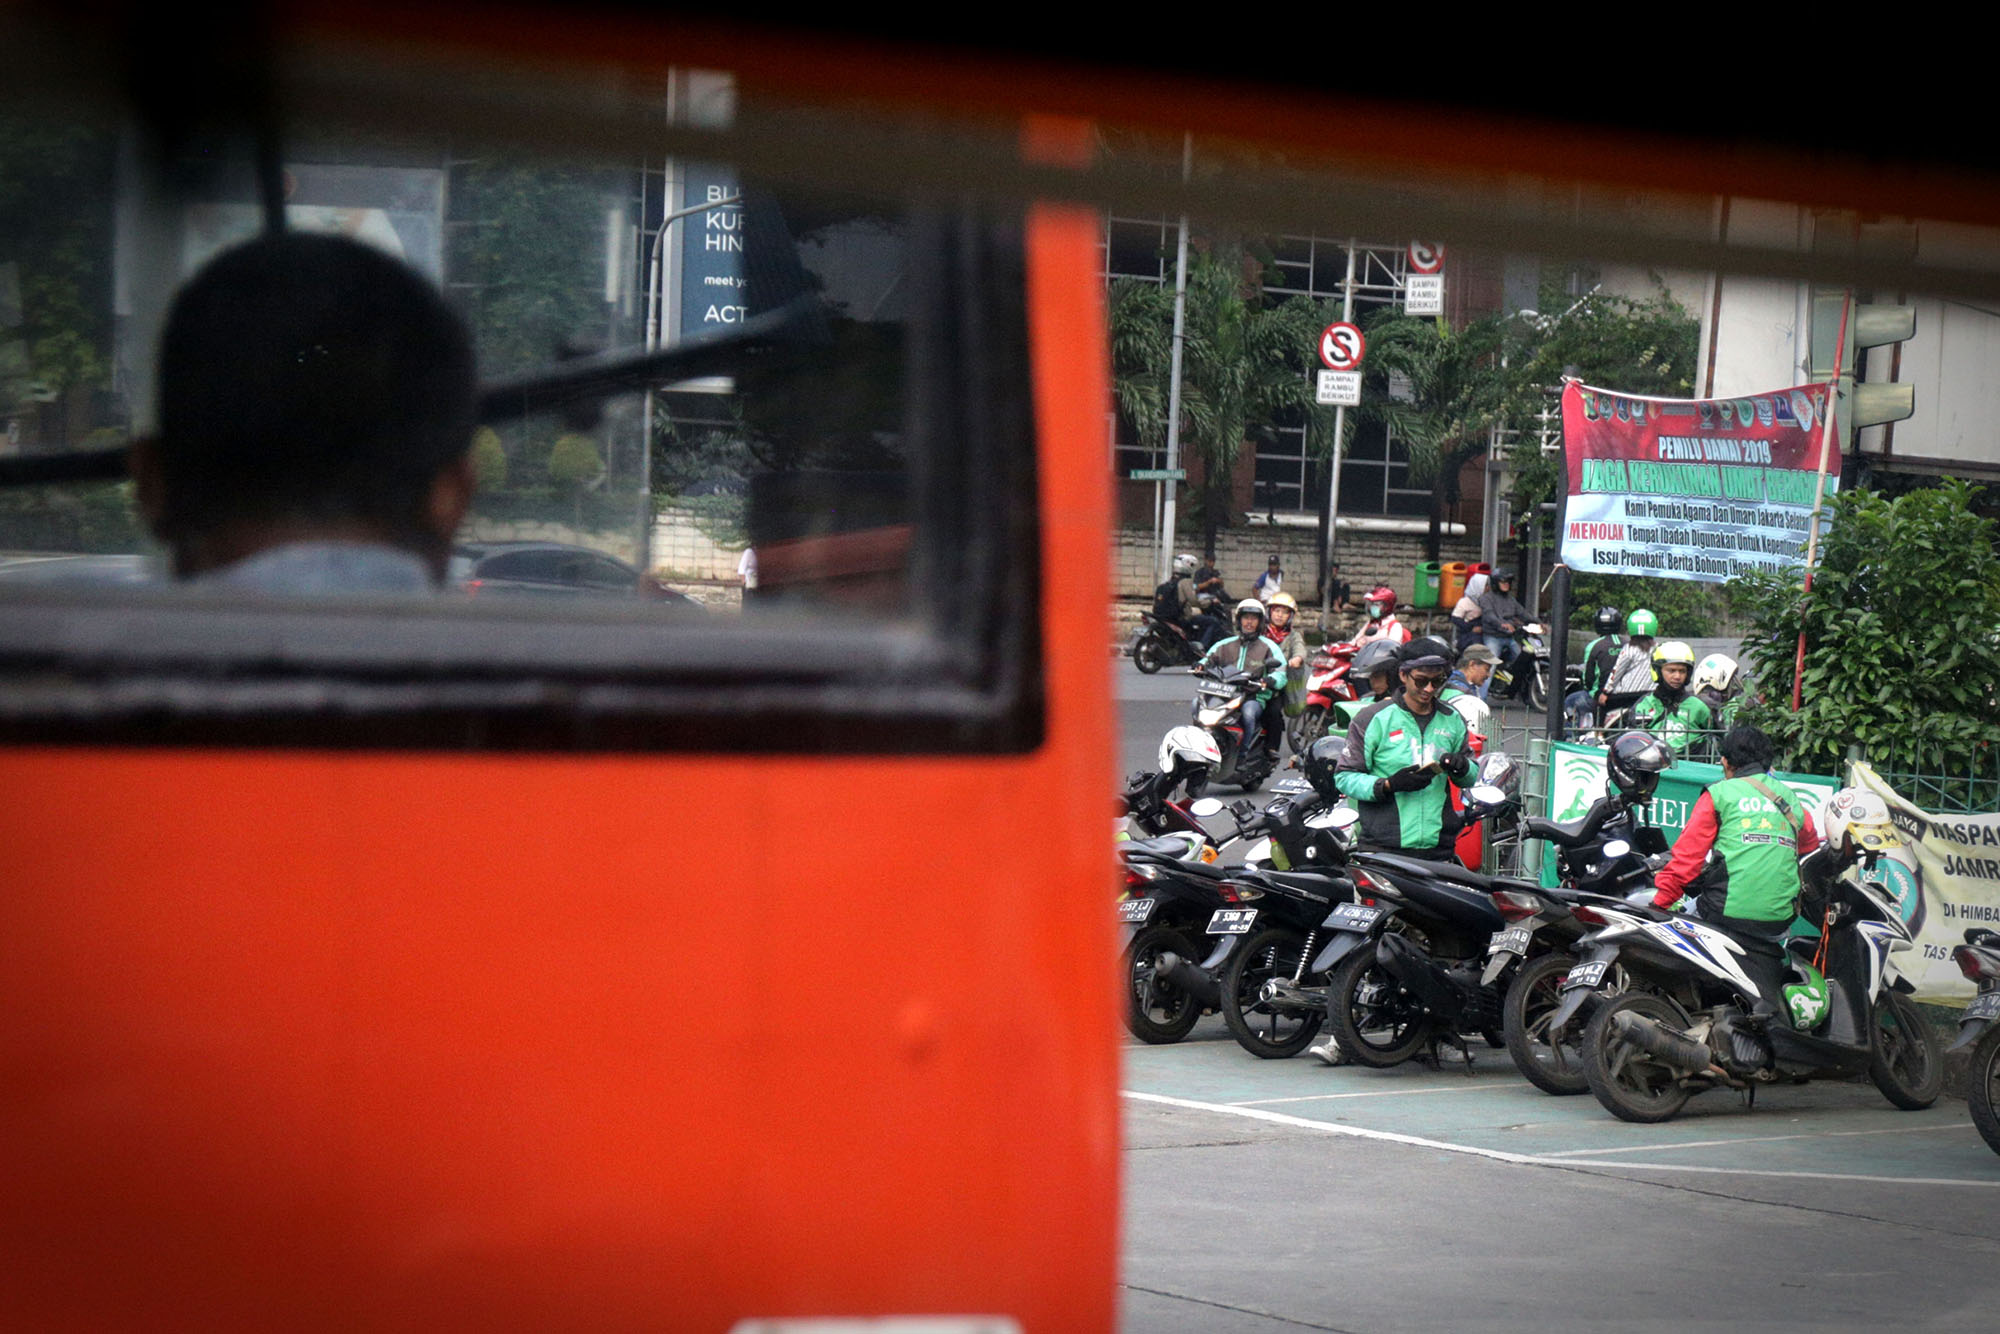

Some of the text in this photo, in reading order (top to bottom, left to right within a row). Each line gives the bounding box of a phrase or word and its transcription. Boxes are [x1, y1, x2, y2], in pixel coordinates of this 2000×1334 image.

[704, 276, 733, 286] meet
[1411, 280, 1438, 289] SAMPAI
[1411, 290, 1437, 298] RAMBU
[1408, 300, 1439, 309] BERIKUT
[1324, 375, 1355, 383] SAMPAI
[1321, 392, 1356, 401] BERIKUT
[1658, 436, 1772, 464] PEMILU DAMAI 2019
[1581, 459, 1629, 492] JAGA
[1628, 460, 1721, 497] KERUKUNAN
[1720, 465, 1764, 500] UMAT
[1625, 500, 1647, 517] Kami
[1648, 501, 1680, 519] Pemuka
[1683, 503, 1711, 523] Agama
[1713, 504, 1729, 523] Dan
[1730, 506, 1756, 526] Umaro
[1757, 508, 1784, 529] Jakarta
[1569, 523, 1625, 540] MENOLAK
[1627, 525, 1659, 544] Tempat
[1660, 527, 1689, 546] Ibadah
[1691, 529, 1736, 550] Digunakan
[1737, 533, 1760, 552] Untuk
[1593, 548, 1618, 566] Issu
[1667, 553, 1693, 573] Berita
[1695, 555, 1728, 577] Bohong
[1893, 814, 1919, 836] JAYA
[1929, 822, 2000, 847] WASPA
[1943, 854, 2000, 881] JAMR
[1943, 902, 1956, 918] DI
[1923, 944, 1948, 961] TAS
